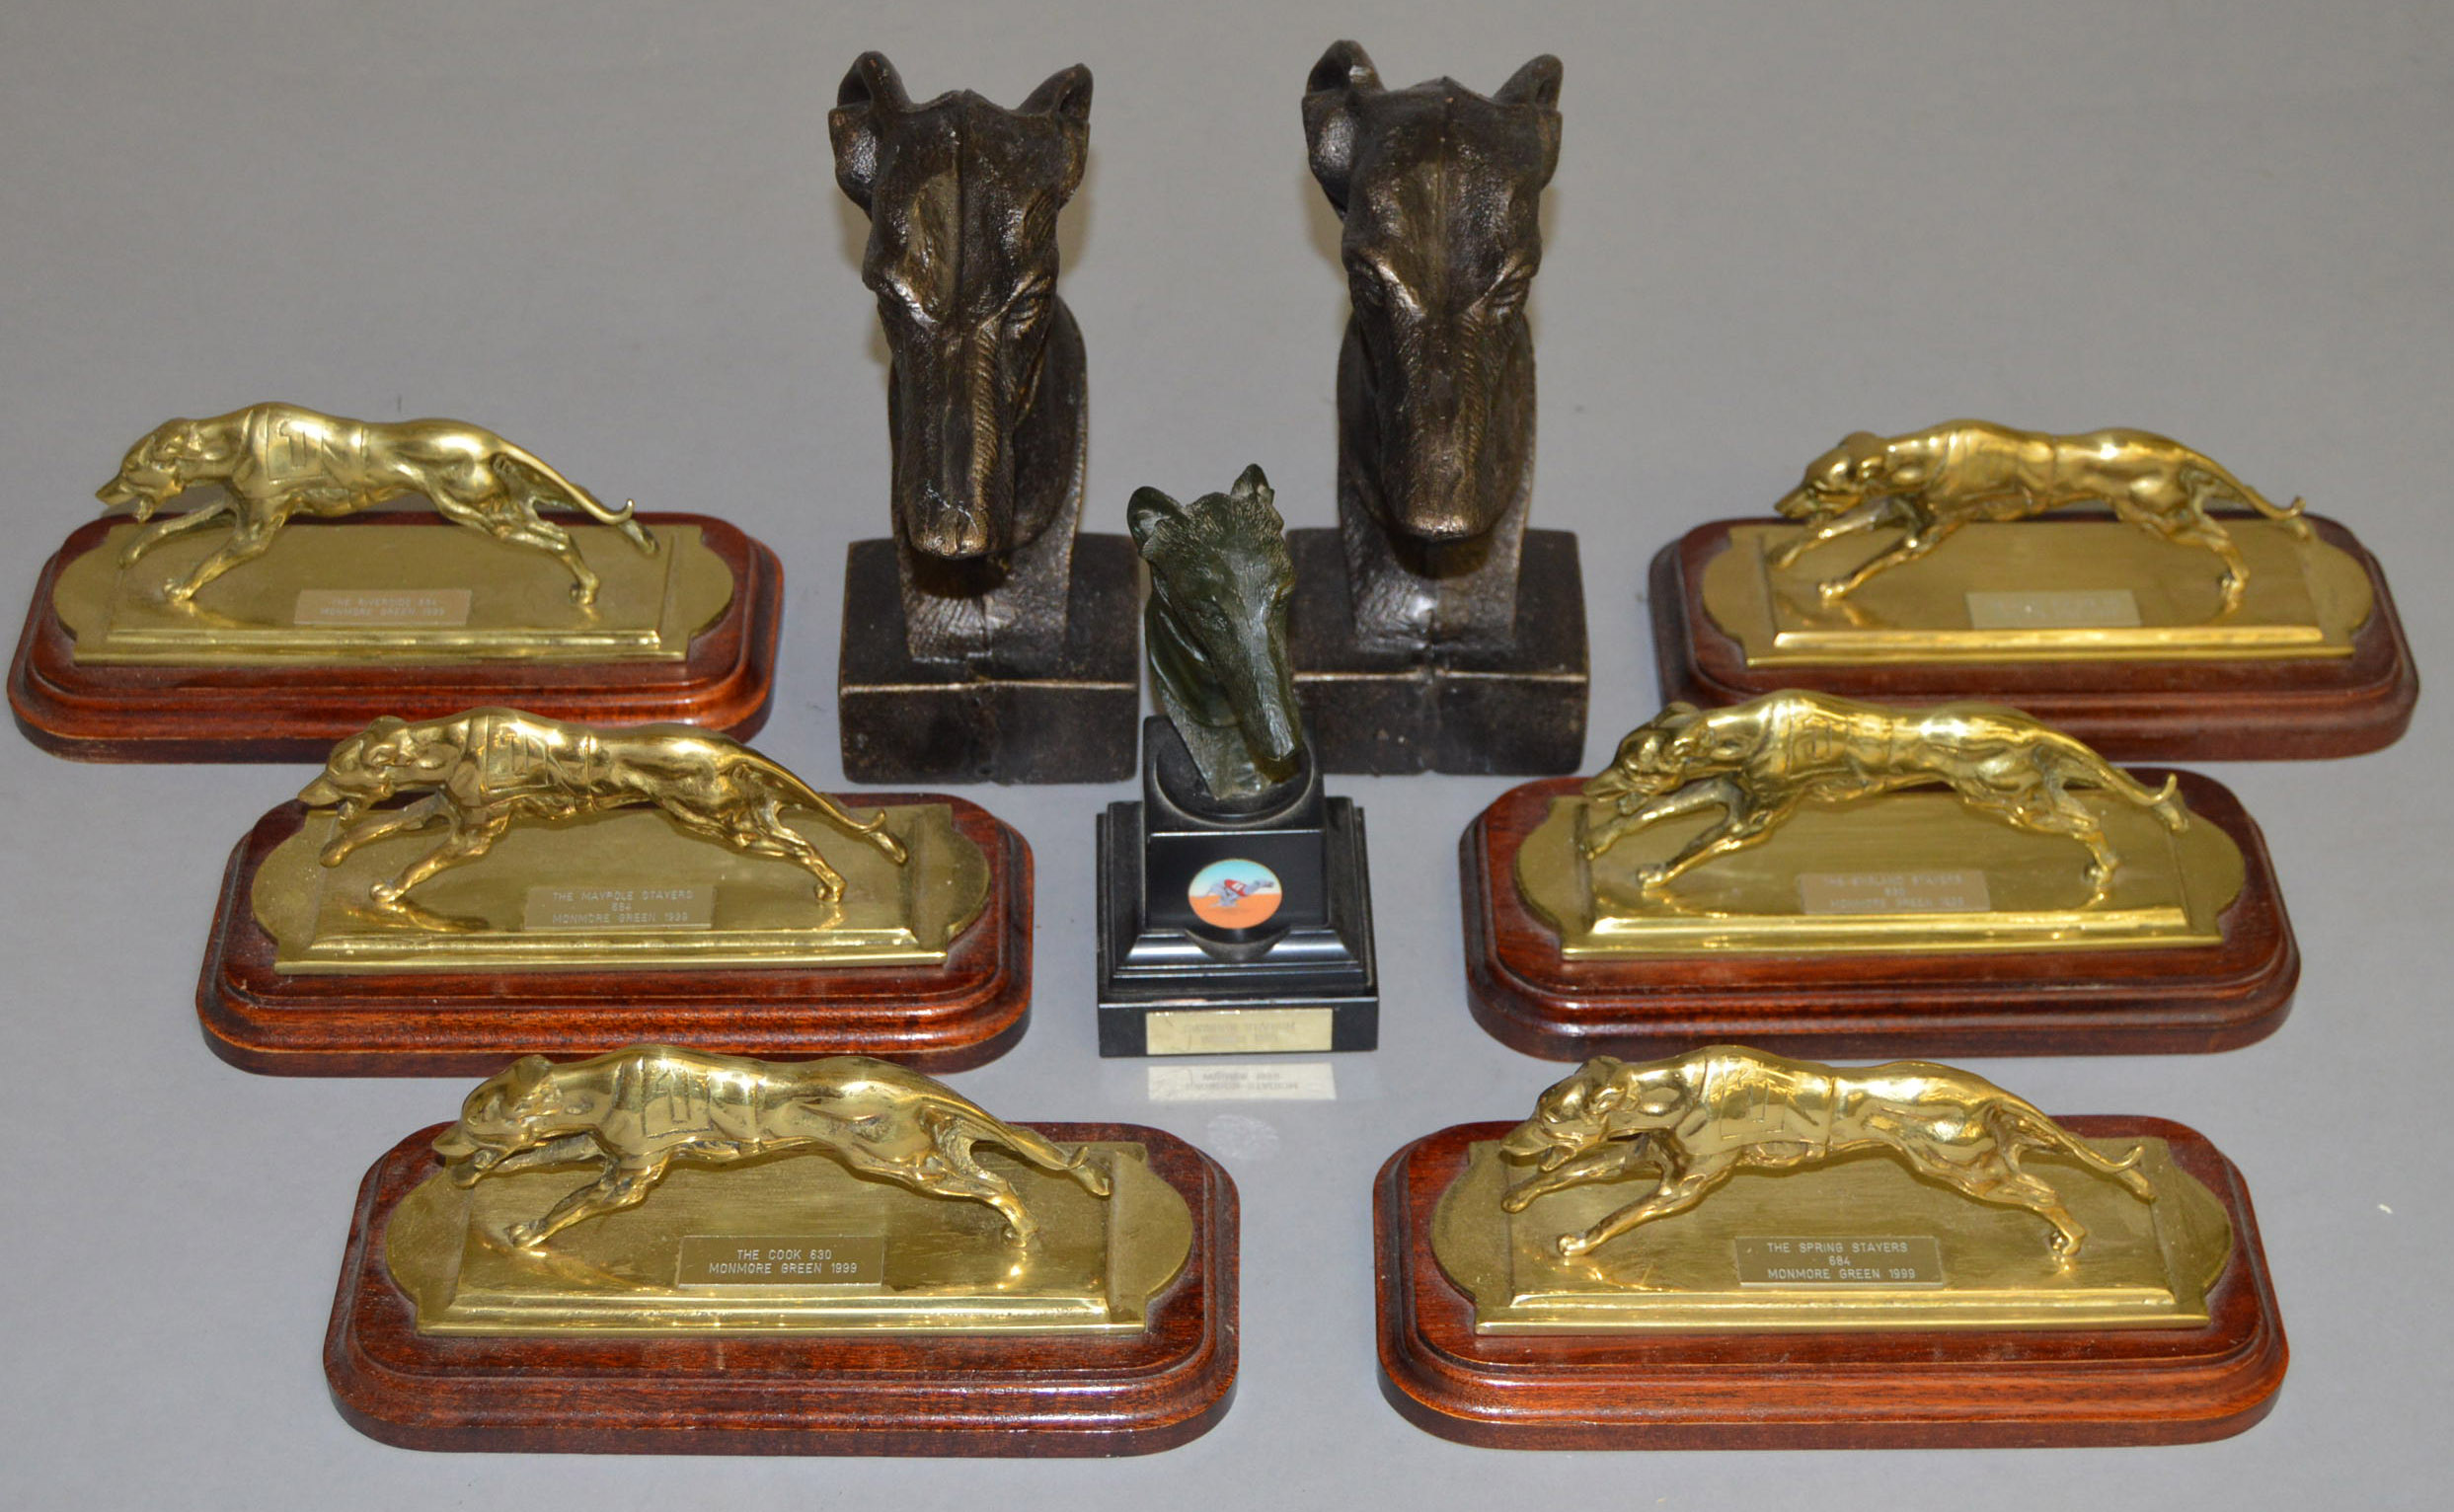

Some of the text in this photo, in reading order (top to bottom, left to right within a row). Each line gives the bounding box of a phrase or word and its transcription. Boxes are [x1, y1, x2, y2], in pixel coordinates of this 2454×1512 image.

[552, 889, 694, 902] THE MAYPOLE STAYERS
[552, 913, 610, 924] MONMORE
[619, 912, 656, 923] GREEN
[1766, 1242, 1909, 1253] THE SPRING STAYERS
[736, 1248, 833, 1260] THE COOK 630
[1828, 1255, 1851, 1266] 684
[709, 1261, 858, 1274] MONMORE GREEN 1999
[1767, 1268, 1916, 1280] MONMORE GREEN 1999
